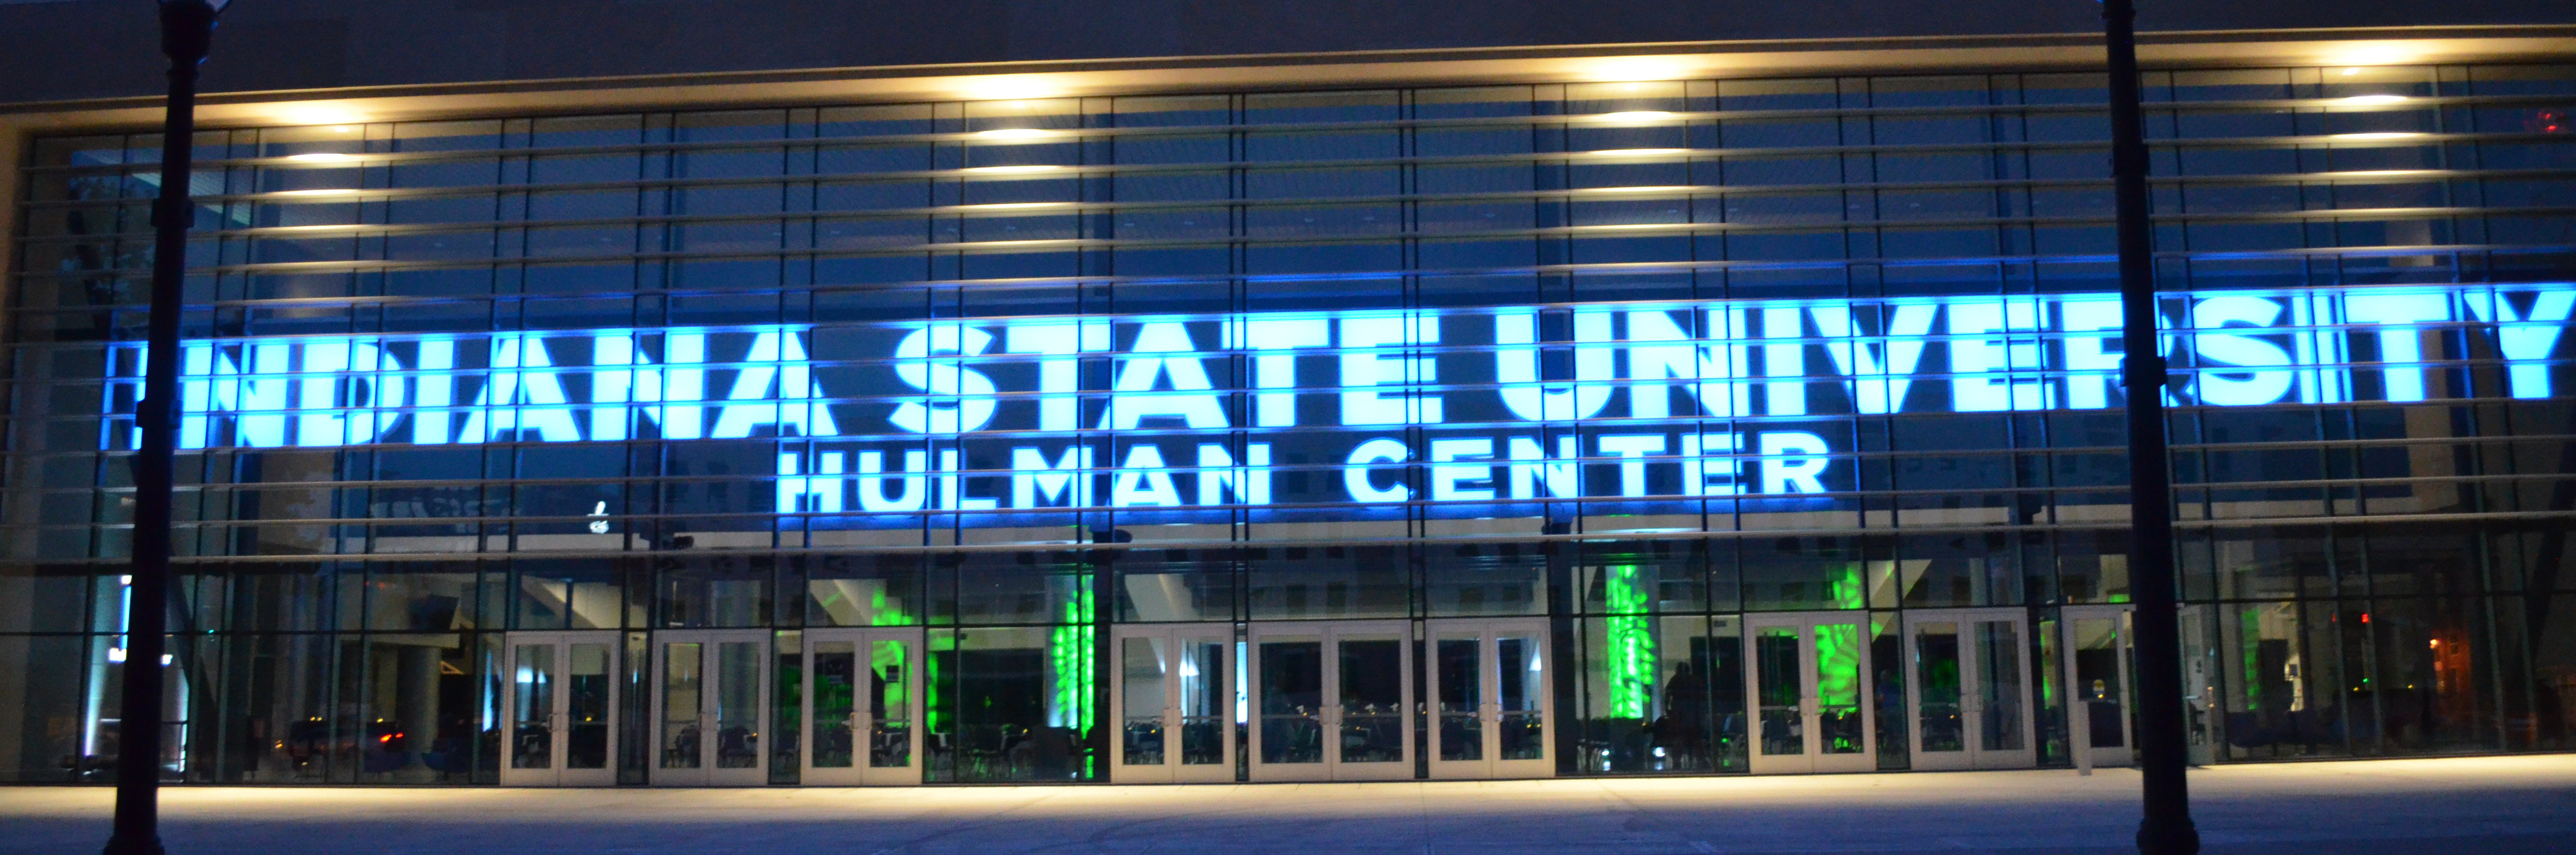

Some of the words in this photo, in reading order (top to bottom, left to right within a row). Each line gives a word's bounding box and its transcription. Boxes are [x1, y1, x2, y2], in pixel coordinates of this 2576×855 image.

[133, 326, 838, 450] NDIANA
[888, 314, 1444, 434] STATE
[1495, 286, 2576, 420] UNIVERSITY
[776, 442, 1272, 513] HULMAN
[1343, 432, 1830, 509] CENTER
